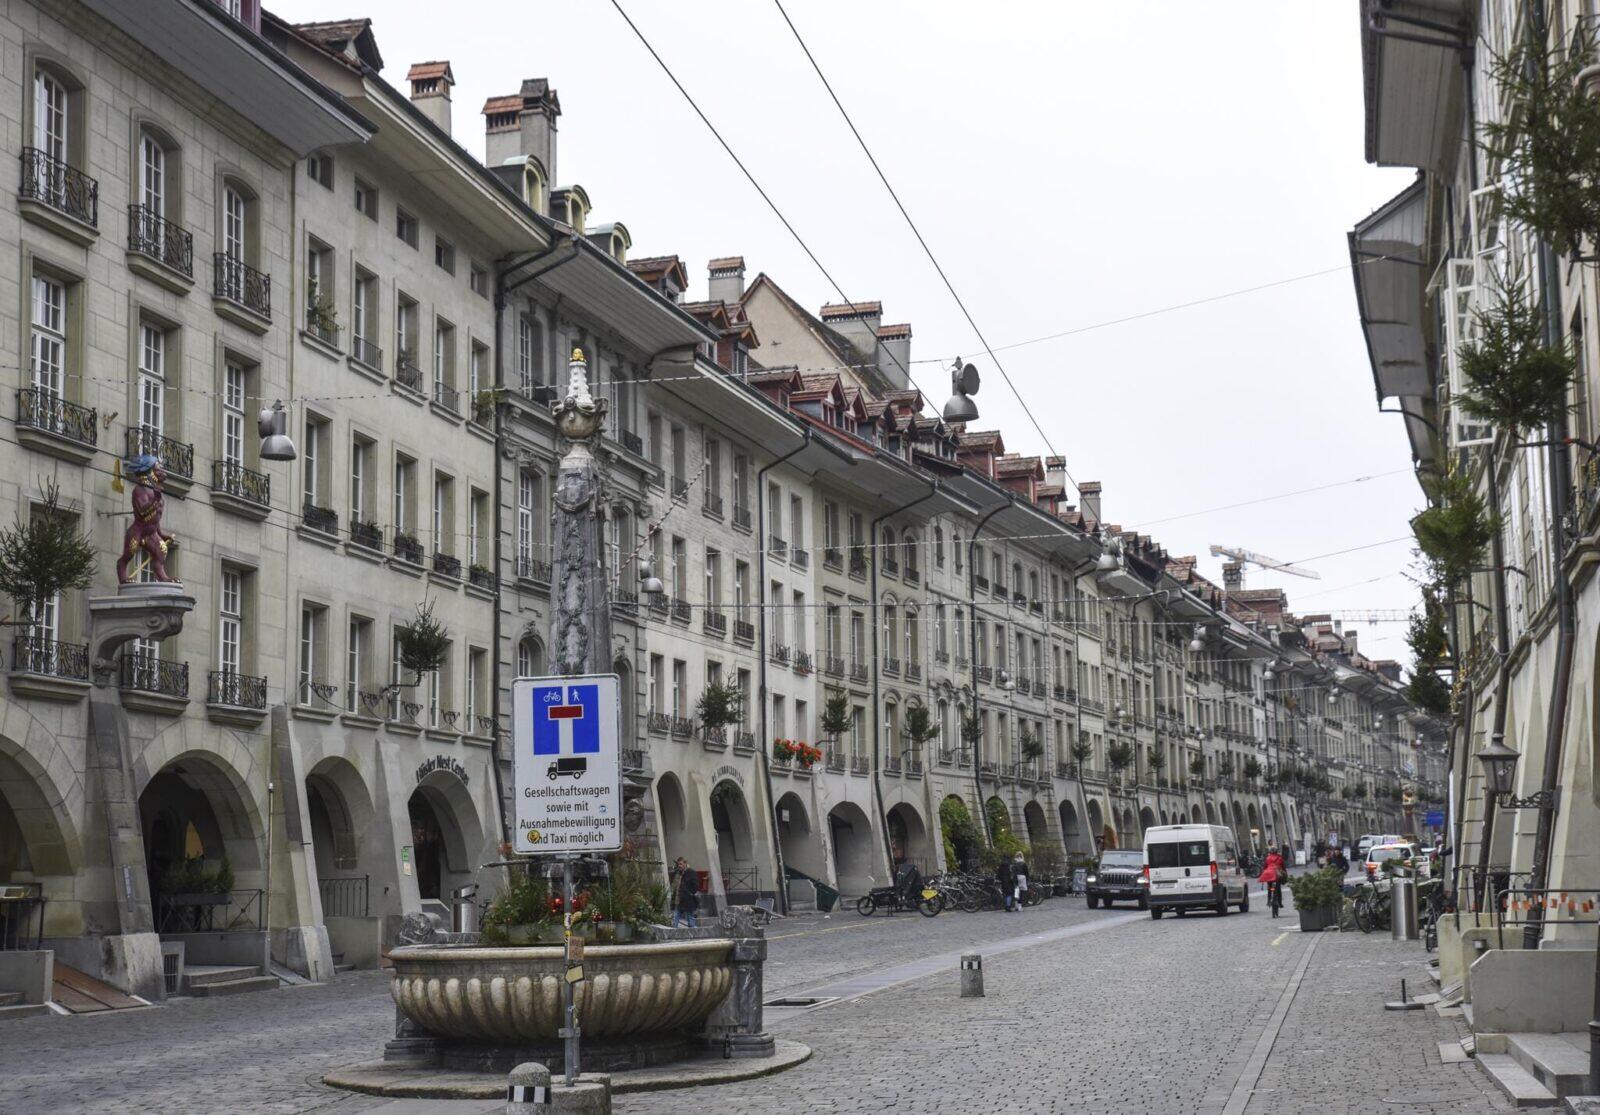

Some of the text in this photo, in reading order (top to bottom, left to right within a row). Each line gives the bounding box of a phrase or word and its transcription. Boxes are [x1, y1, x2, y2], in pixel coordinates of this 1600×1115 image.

[524, 785, 610, 798] Gesellschaftswagen
[546, 801, 589, 813] sowie mit
[520, 816, 616, 829] Ausnahmebewilligung
[530, 831, 604, 845] nd Taxi möglich
